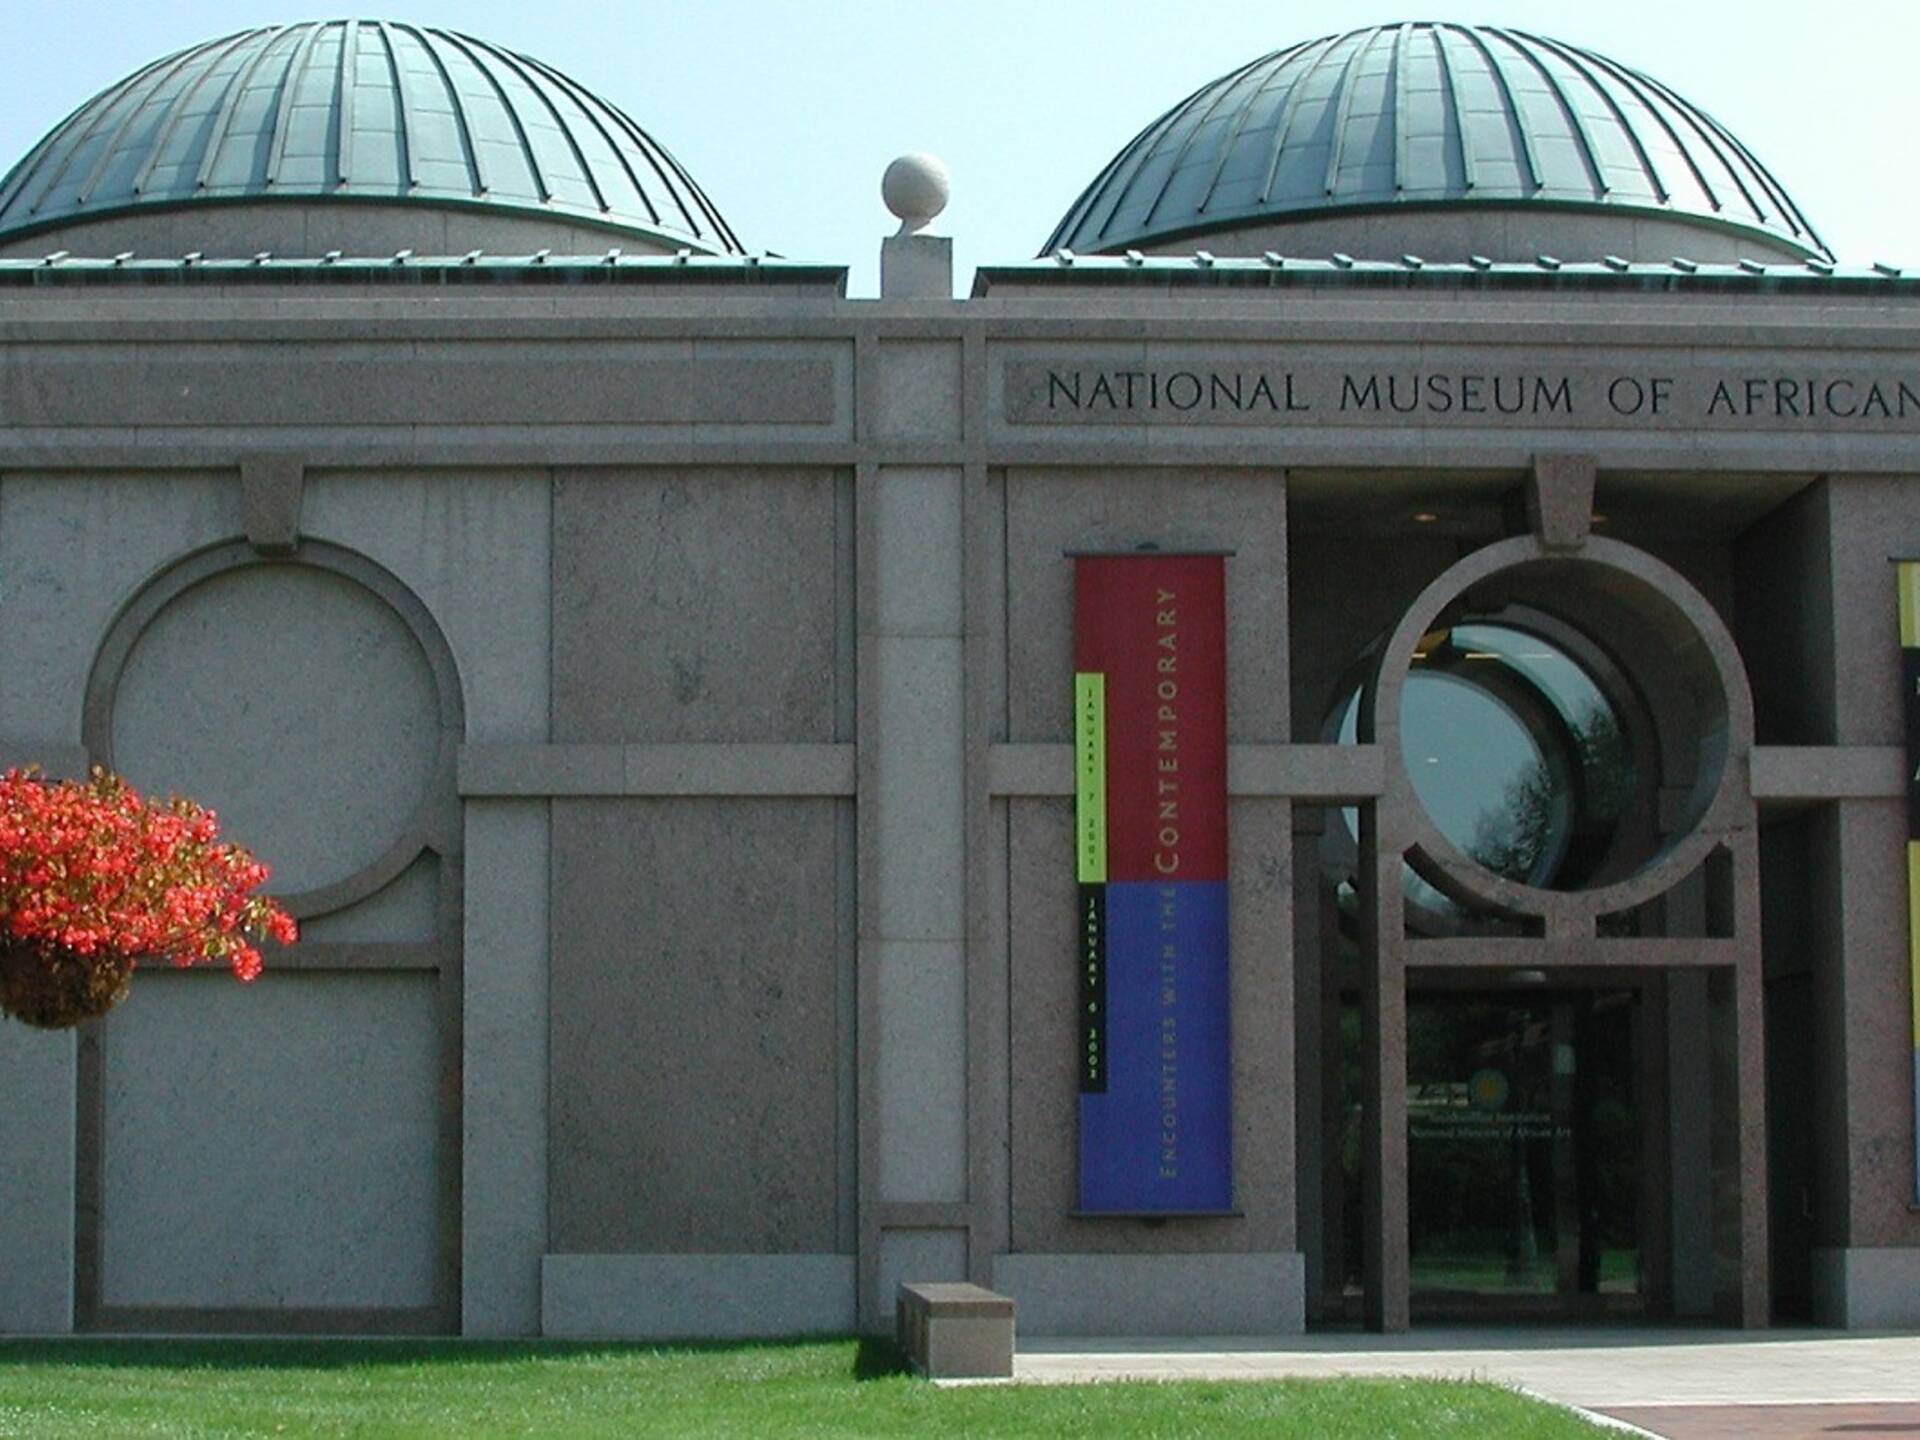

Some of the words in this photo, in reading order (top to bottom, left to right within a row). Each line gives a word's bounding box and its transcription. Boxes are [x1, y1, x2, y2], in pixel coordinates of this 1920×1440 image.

[1048, 371, 1310, 411] NATIONAL
[1339, 373, 1573, 413] MUSEUM
[1608, 376, 1674, 415] OF
[1085, 687, 1096, 775] JANUARY
[1154, 588, 1180, 874] CONTEMPORARY
[1087, 897, 1098, 987] JANUARY
[1160, 886, 1177, 930] THE
[1161, 944, 1177, 1005] WITH
[1159, 1016, 1177, 1179] ENCOUNTERS
